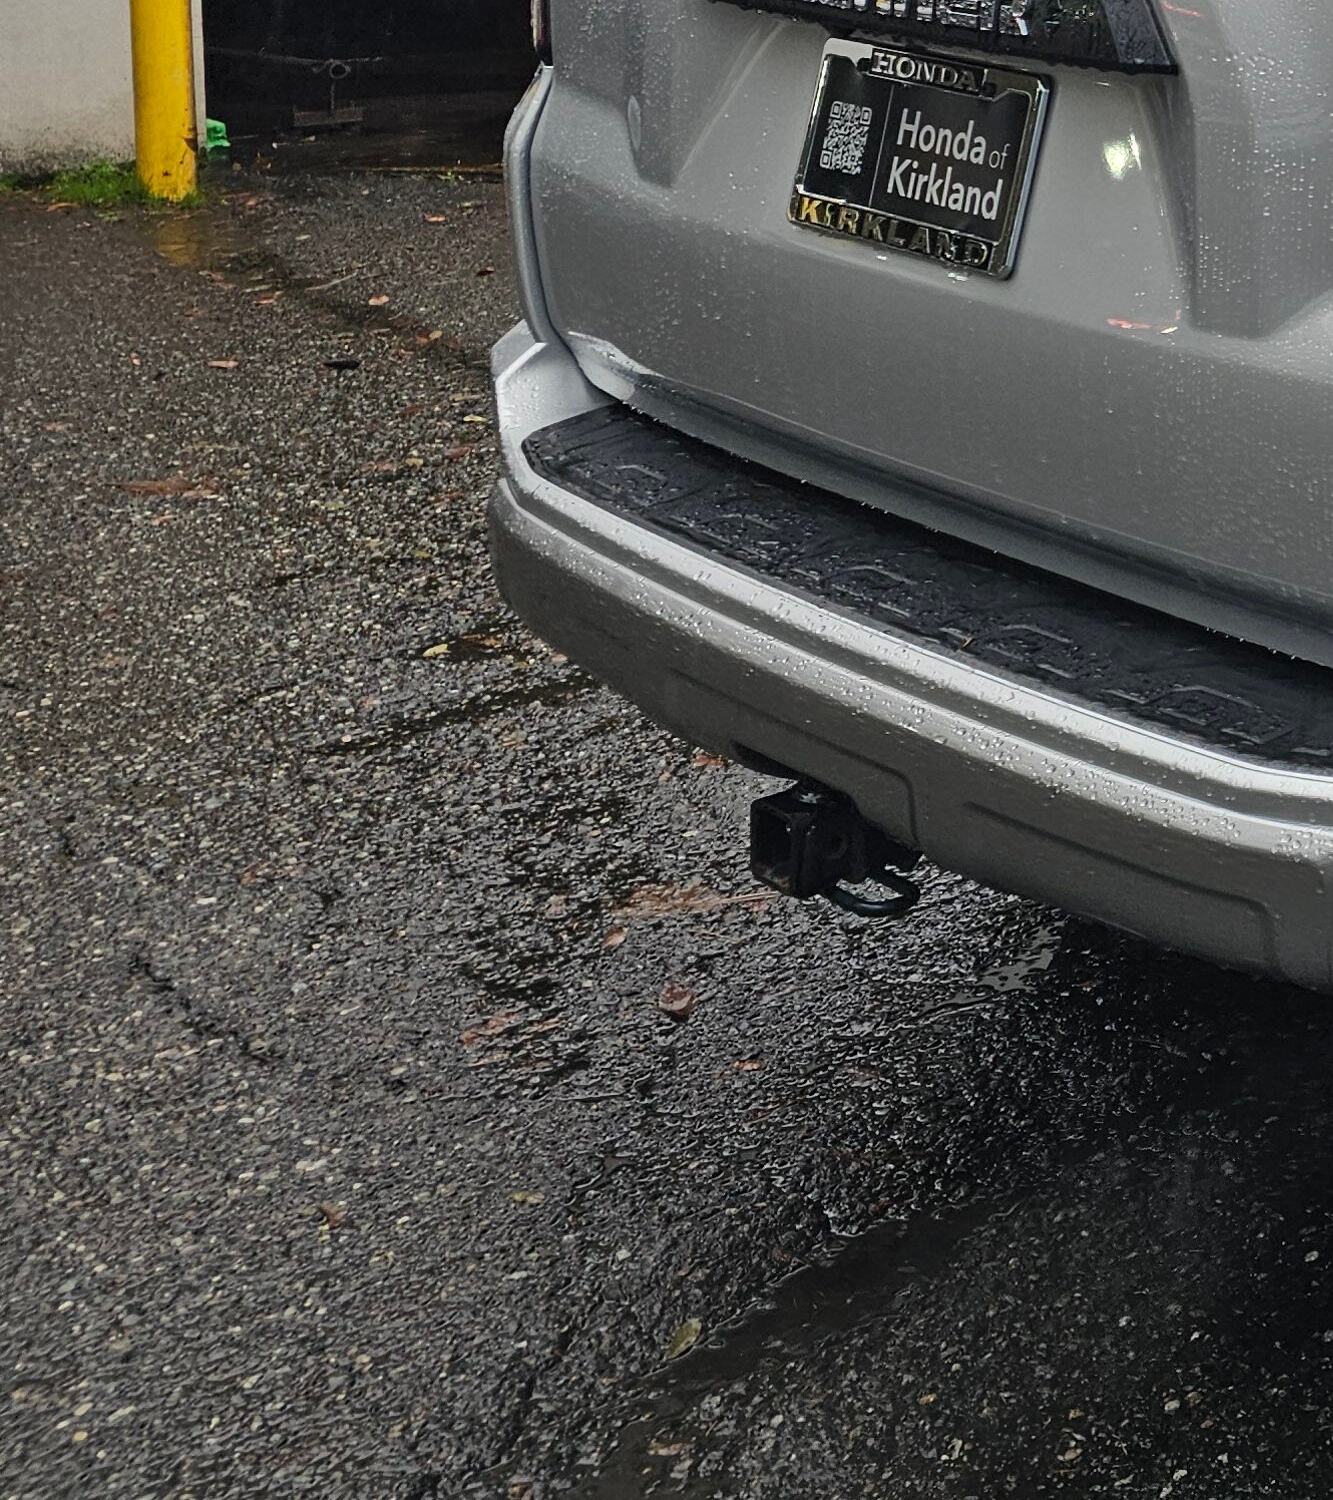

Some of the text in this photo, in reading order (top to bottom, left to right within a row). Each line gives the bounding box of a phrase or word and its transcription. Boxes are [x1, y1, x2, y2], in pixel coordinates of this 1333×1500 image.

[871, 51, 981, 92] HONDA
[896, 107, 1012, 171] Honda of
[887, 155, 1004, 221] Kirkland
[799, 196, 989, 266] KIRKLAND
